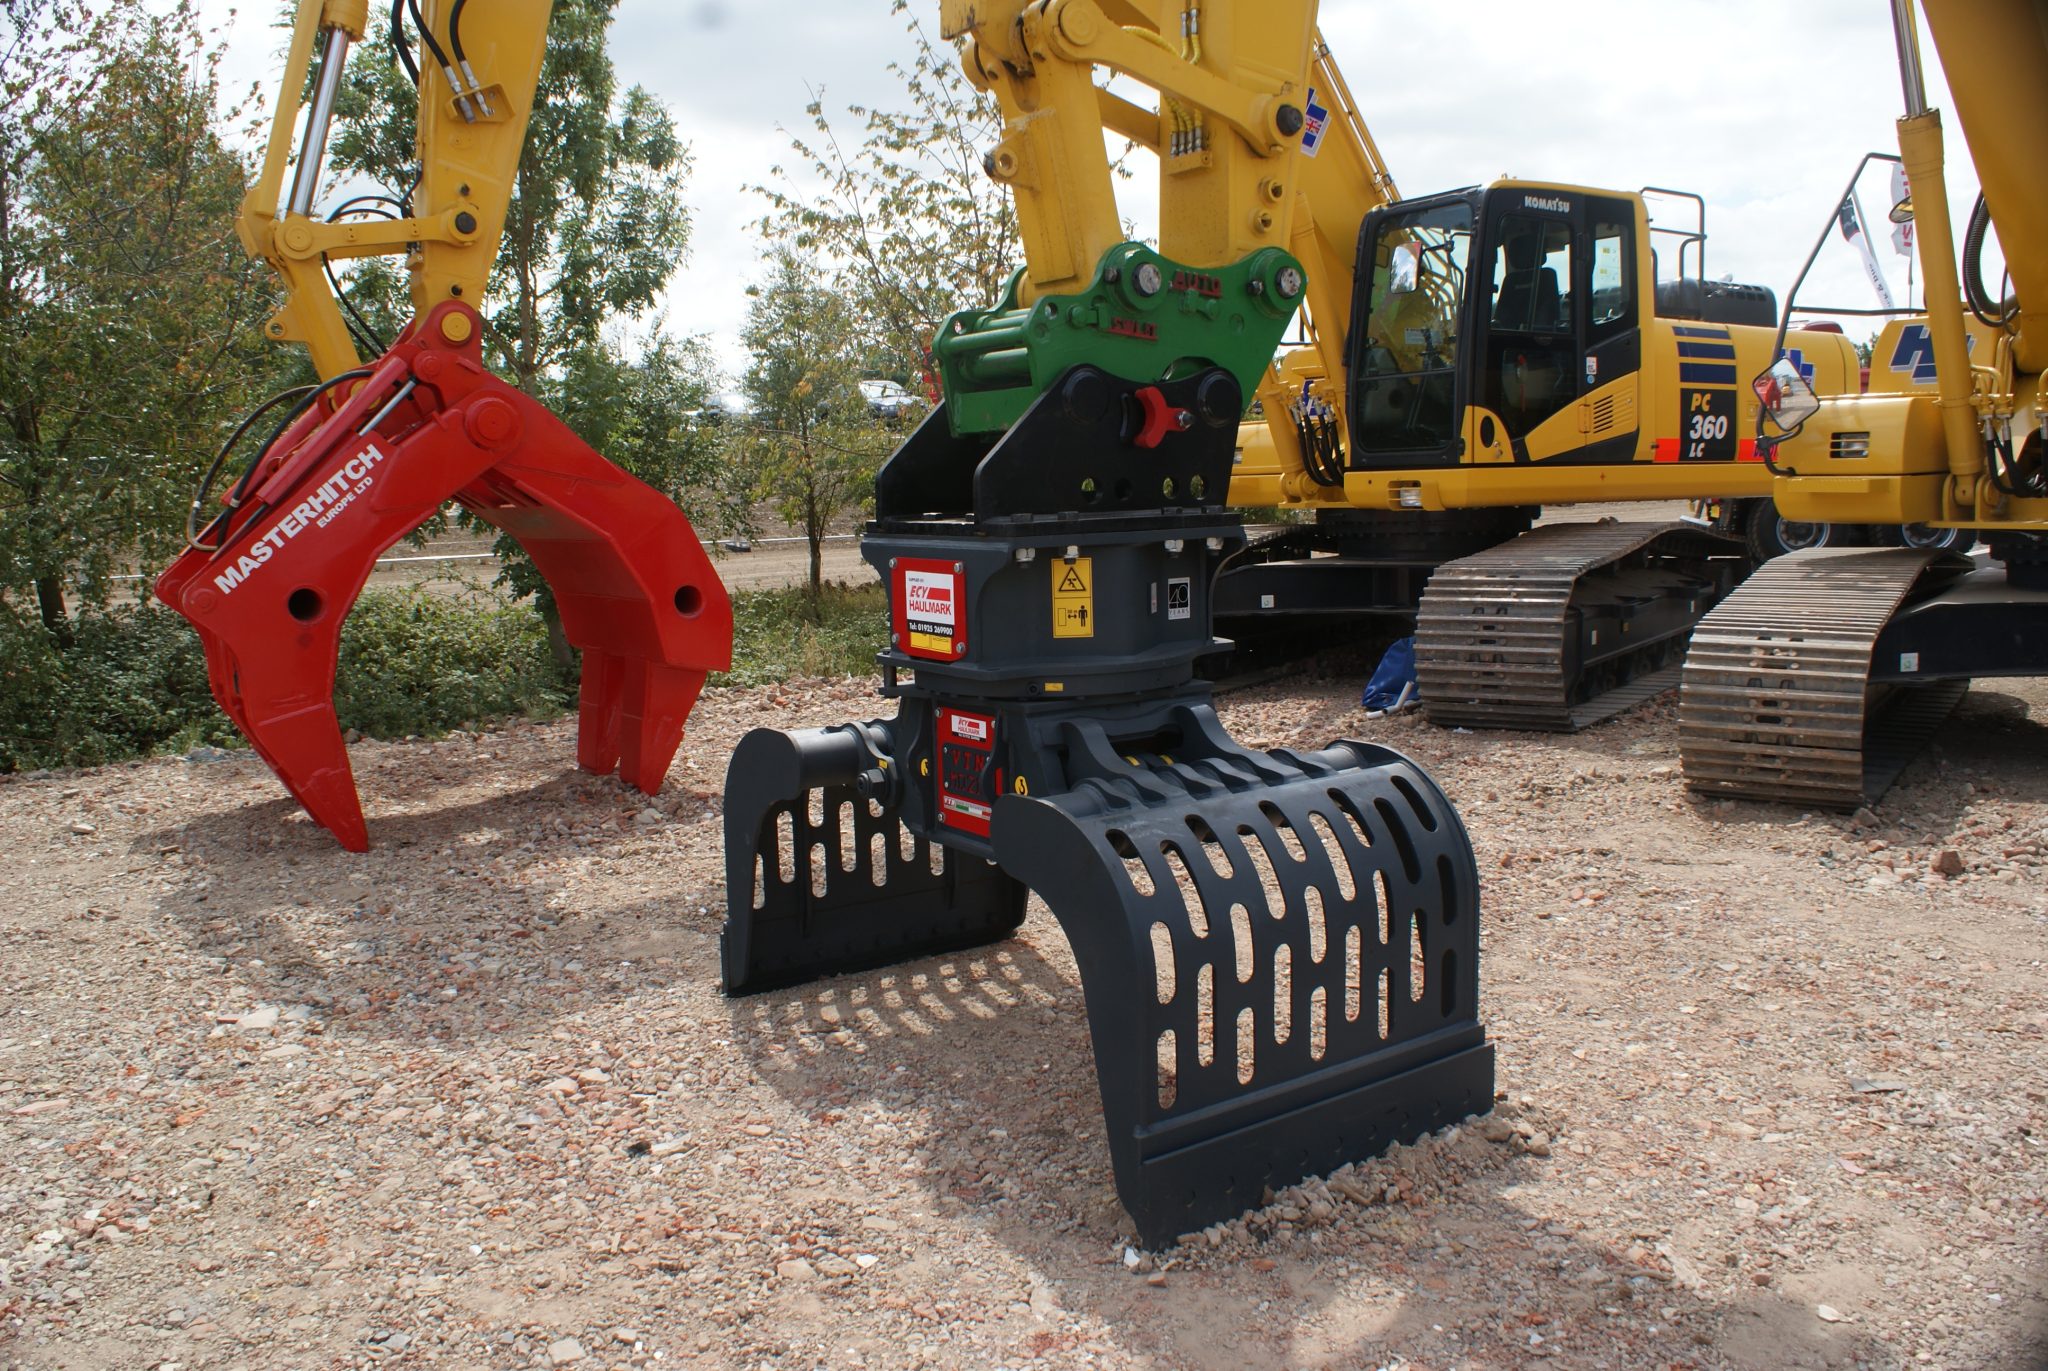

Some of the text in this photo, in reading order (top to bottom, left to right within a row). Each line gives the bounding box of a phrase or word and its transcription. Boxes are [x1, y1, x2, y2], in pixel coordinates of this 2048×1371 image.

[1524, 195, 1570, 213] KOMATSU
[1173, 269, 1221, 294] AUTO
[1691, 393, 1712, 412] PC
[1689, 414, 1728, 440] 360
[1688, 442, 1705, 458] LC
[316, 476, 373, 529] EUROPE LTD
[214, 444, 384, 595] MASTERHITCH
[910, 586, 928, 598] ECY
[1168, 584, 1189, 608] 40
[909, 600, 952, 615] HAULMARK
[909, 622, 917, 630] Tel:
[951, 749, 984, 772] VTN
